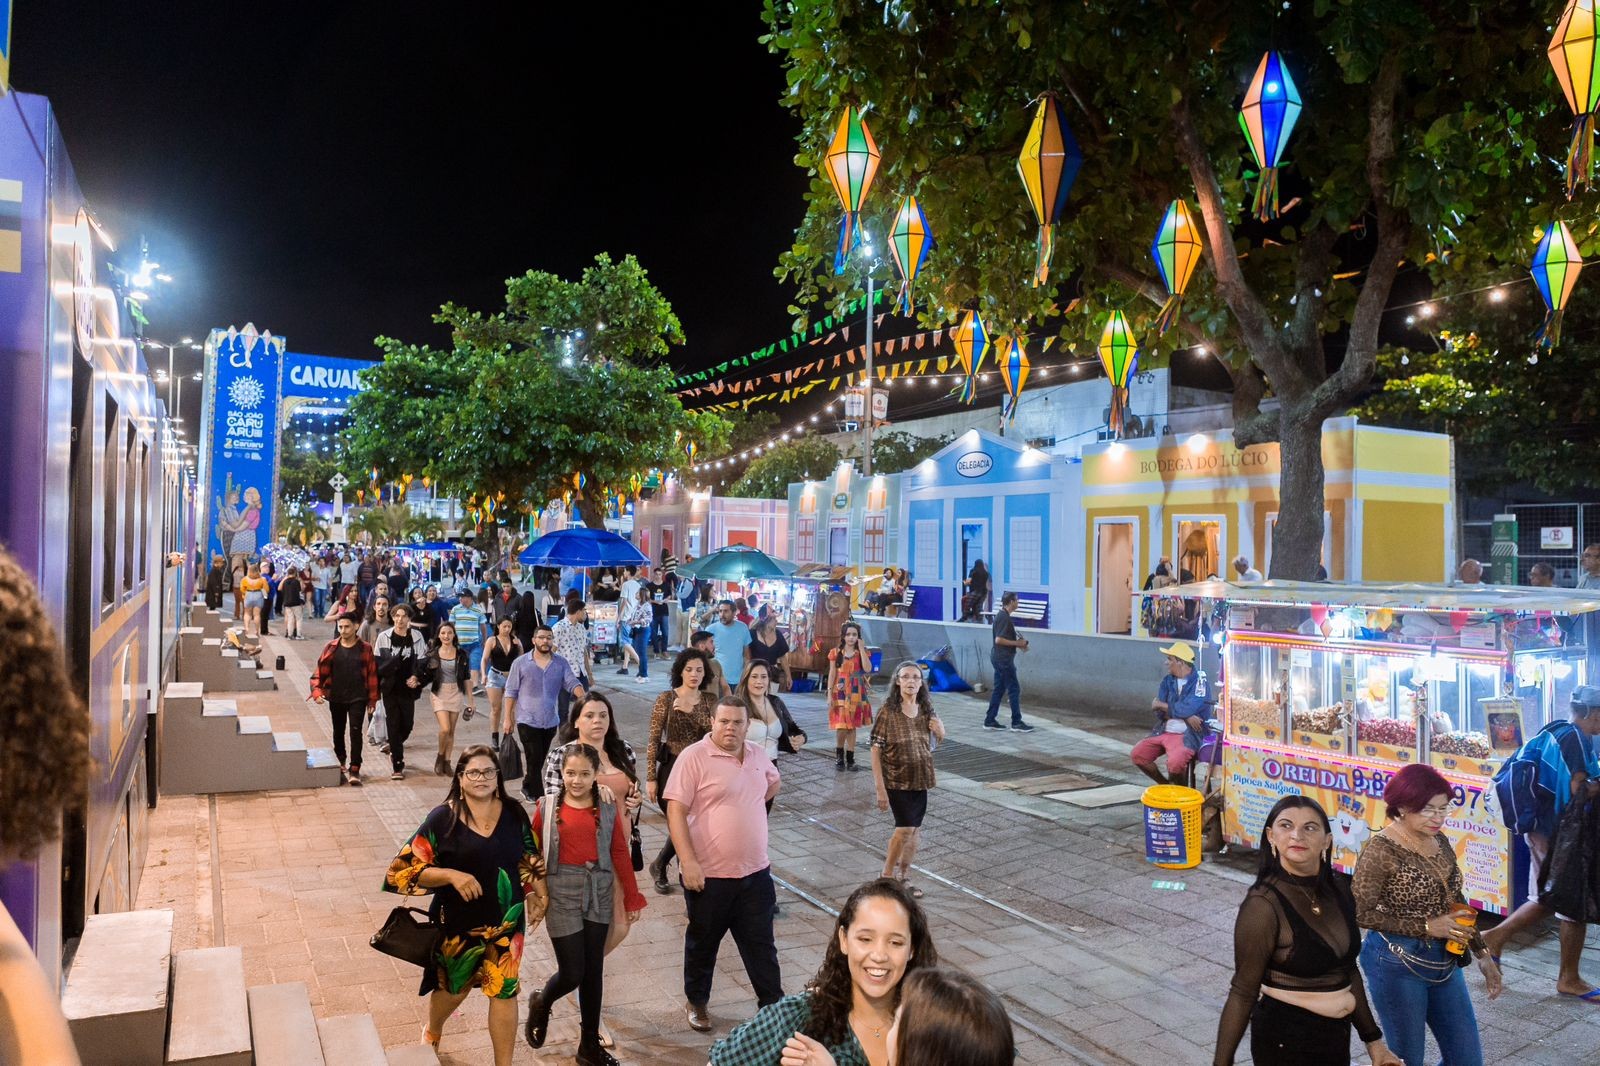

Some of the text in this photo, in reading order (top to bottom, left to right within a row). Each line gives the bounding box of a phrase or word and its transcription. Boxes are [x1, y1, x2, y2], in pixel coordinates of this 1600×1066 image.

[290, 365, 371, 391] CARUAR
[227, 417, 263, 428] CARU
[227, 427, 254, 437] ARU
[233, 440, 264, 448] Caruaru
[958, 459, 990, 470] DELEGACIA
[1140, 450, 1268, 474] BODEGA DO LÚCIO
[1263, 758, 1282, 778] O
[1284, 763, 1317, 785] REI
[1319, 769, 1351, 792] DA
[1234, 774, 1301, 795] Pipoca Salgada
[1463, 820, 1496, 836] Doce
[1467, 840, 1497, 851] Laranja
[1481, 851, 1499, 860] Azul
[1466, 856, 1498, 868] Chiclete
[1465, 882, 1499, 894] Groselha
